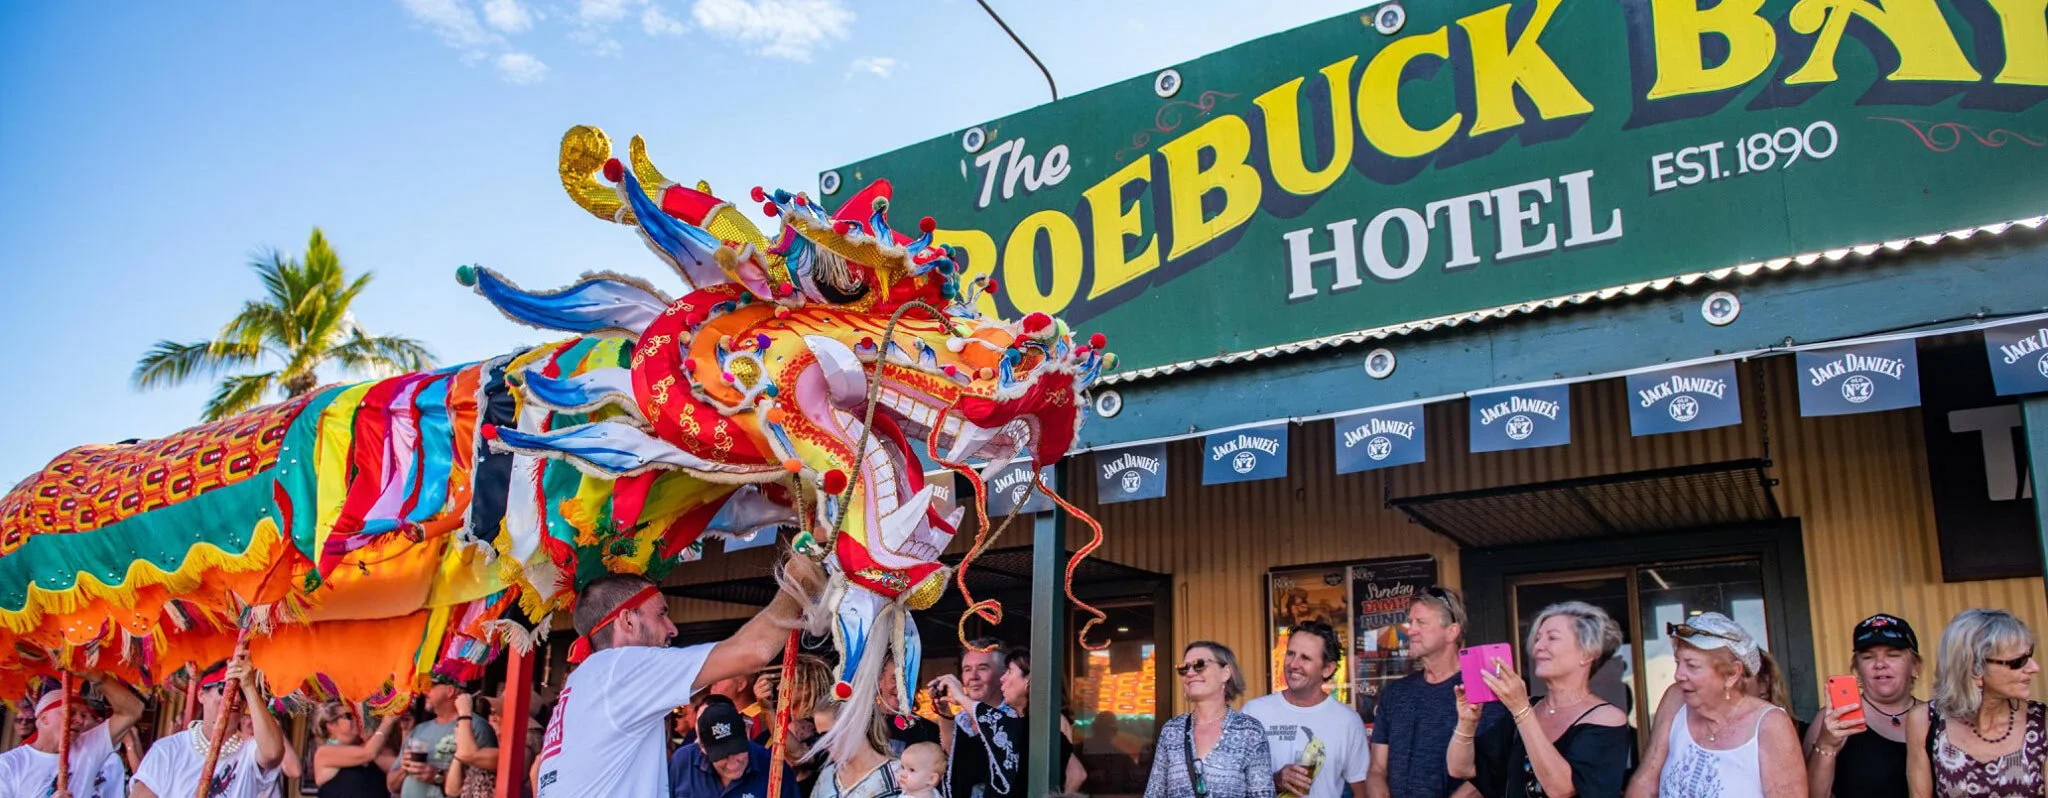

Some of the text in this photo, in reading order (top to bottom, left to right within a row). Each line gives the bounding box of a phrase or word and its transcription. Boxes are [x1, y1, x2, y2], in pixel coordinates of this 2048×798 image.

[1651, 120, 1838, 191] EST. 1890
[975, 137, 1071, 208] The
[1283, 170, 1623, 299] HOTEL
[2000, 335, 2041, 364] JACK
[1809, 353, 1905, 386] JACK DANIEL'S
[1639, 375, 1727, 407] JACK DANIEL'S
[1480, 396, 1560, 425] JACK DANIEL'S
[1213, 434, 1280, 460] JACK DANIEL'S
[1344, 418, 1415, 447] JACK DANIEL'S
[1102, 453, 1160, 479] JACK DANIEL'S
[1948, 403, 2032, 501] T
[994, 473, 1015, 493] JACK
[1366, 581, 1414, 600] Sunday
